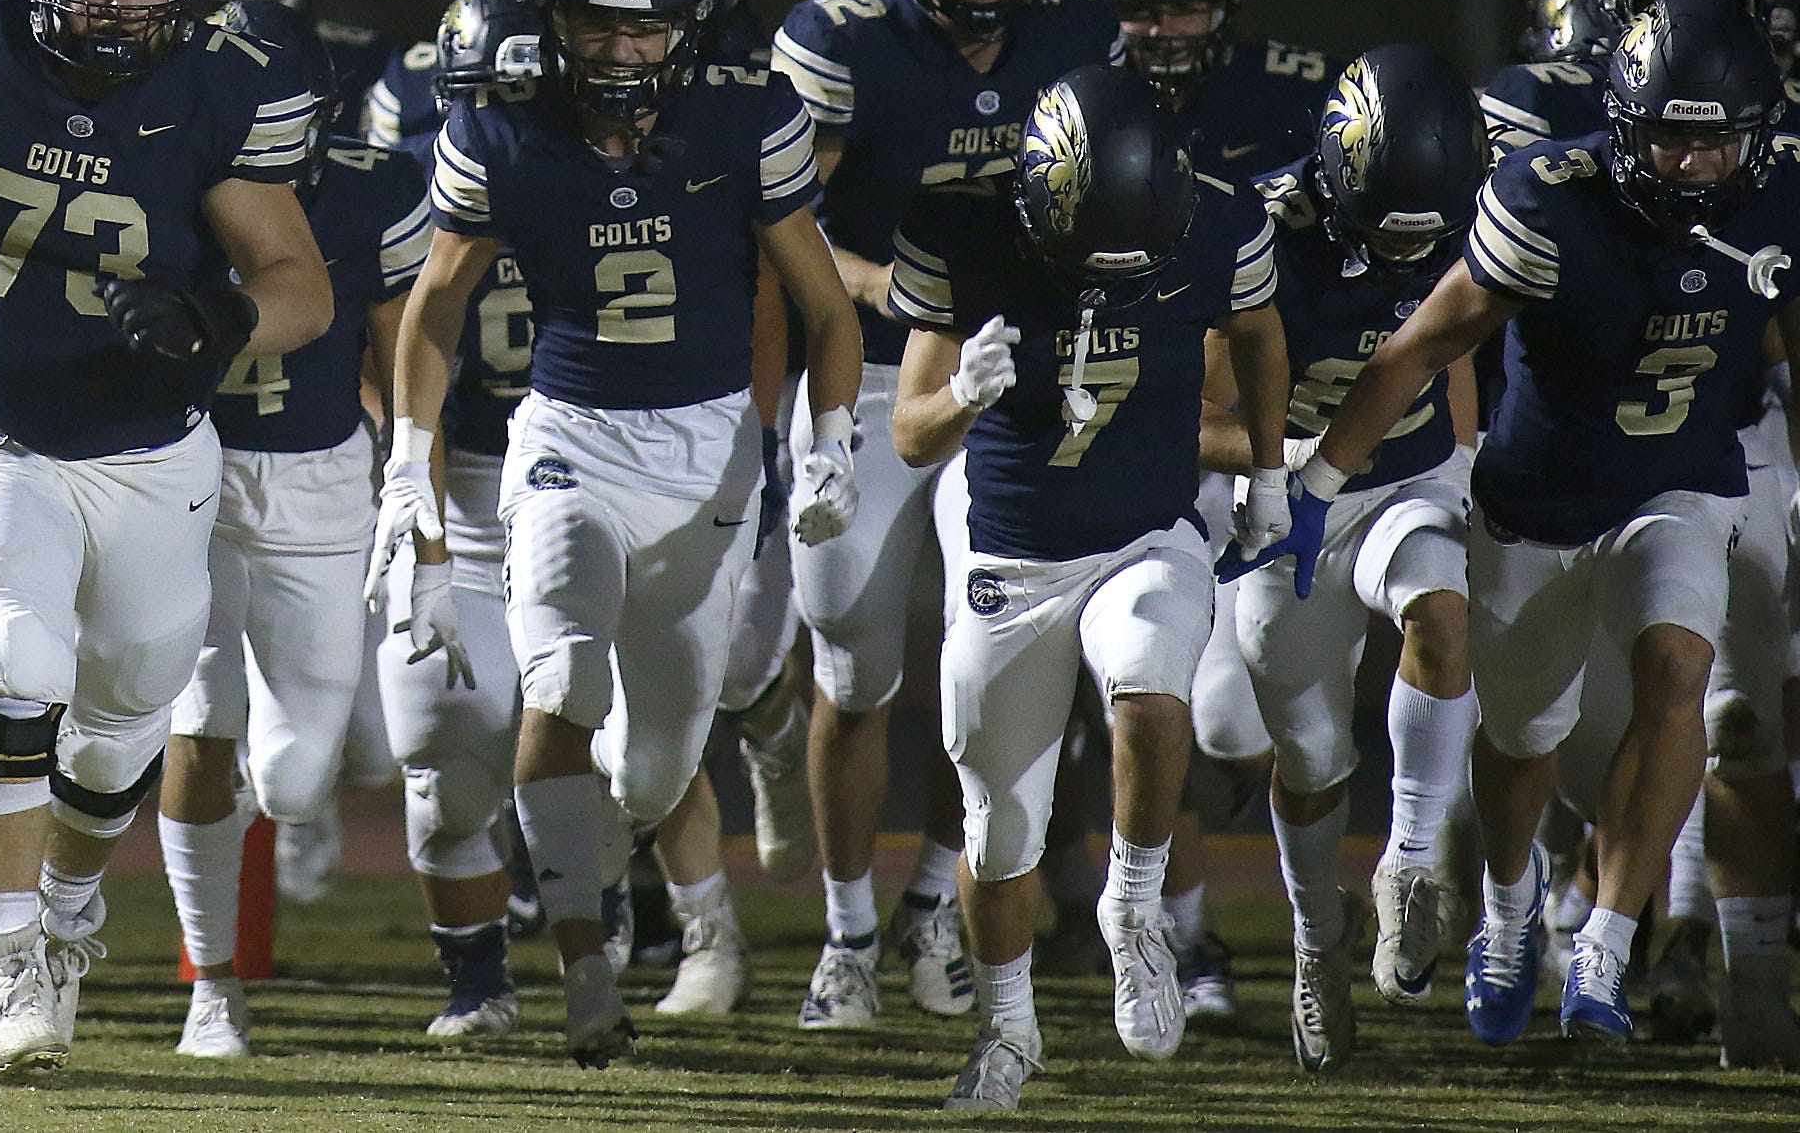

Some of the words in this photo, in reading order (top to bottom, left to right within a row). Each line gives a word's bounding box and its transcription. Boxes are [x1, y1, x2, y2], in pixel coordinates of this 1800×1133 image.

[1671, 103, 1719, 116] Riddell
[948, 122, 1022, 155] COLTS
[26, 142, 112, 185] COLTS
[588, 215, 673, 248] COLTS
[594, 248, 677, 345] 2
[1645, 309, 1728, 341] COLTS
[1054, 326, 1141, 358] CLTS
[1615, 345, 1719, 436] 3
[1046, 356, 1140, 468] 7
